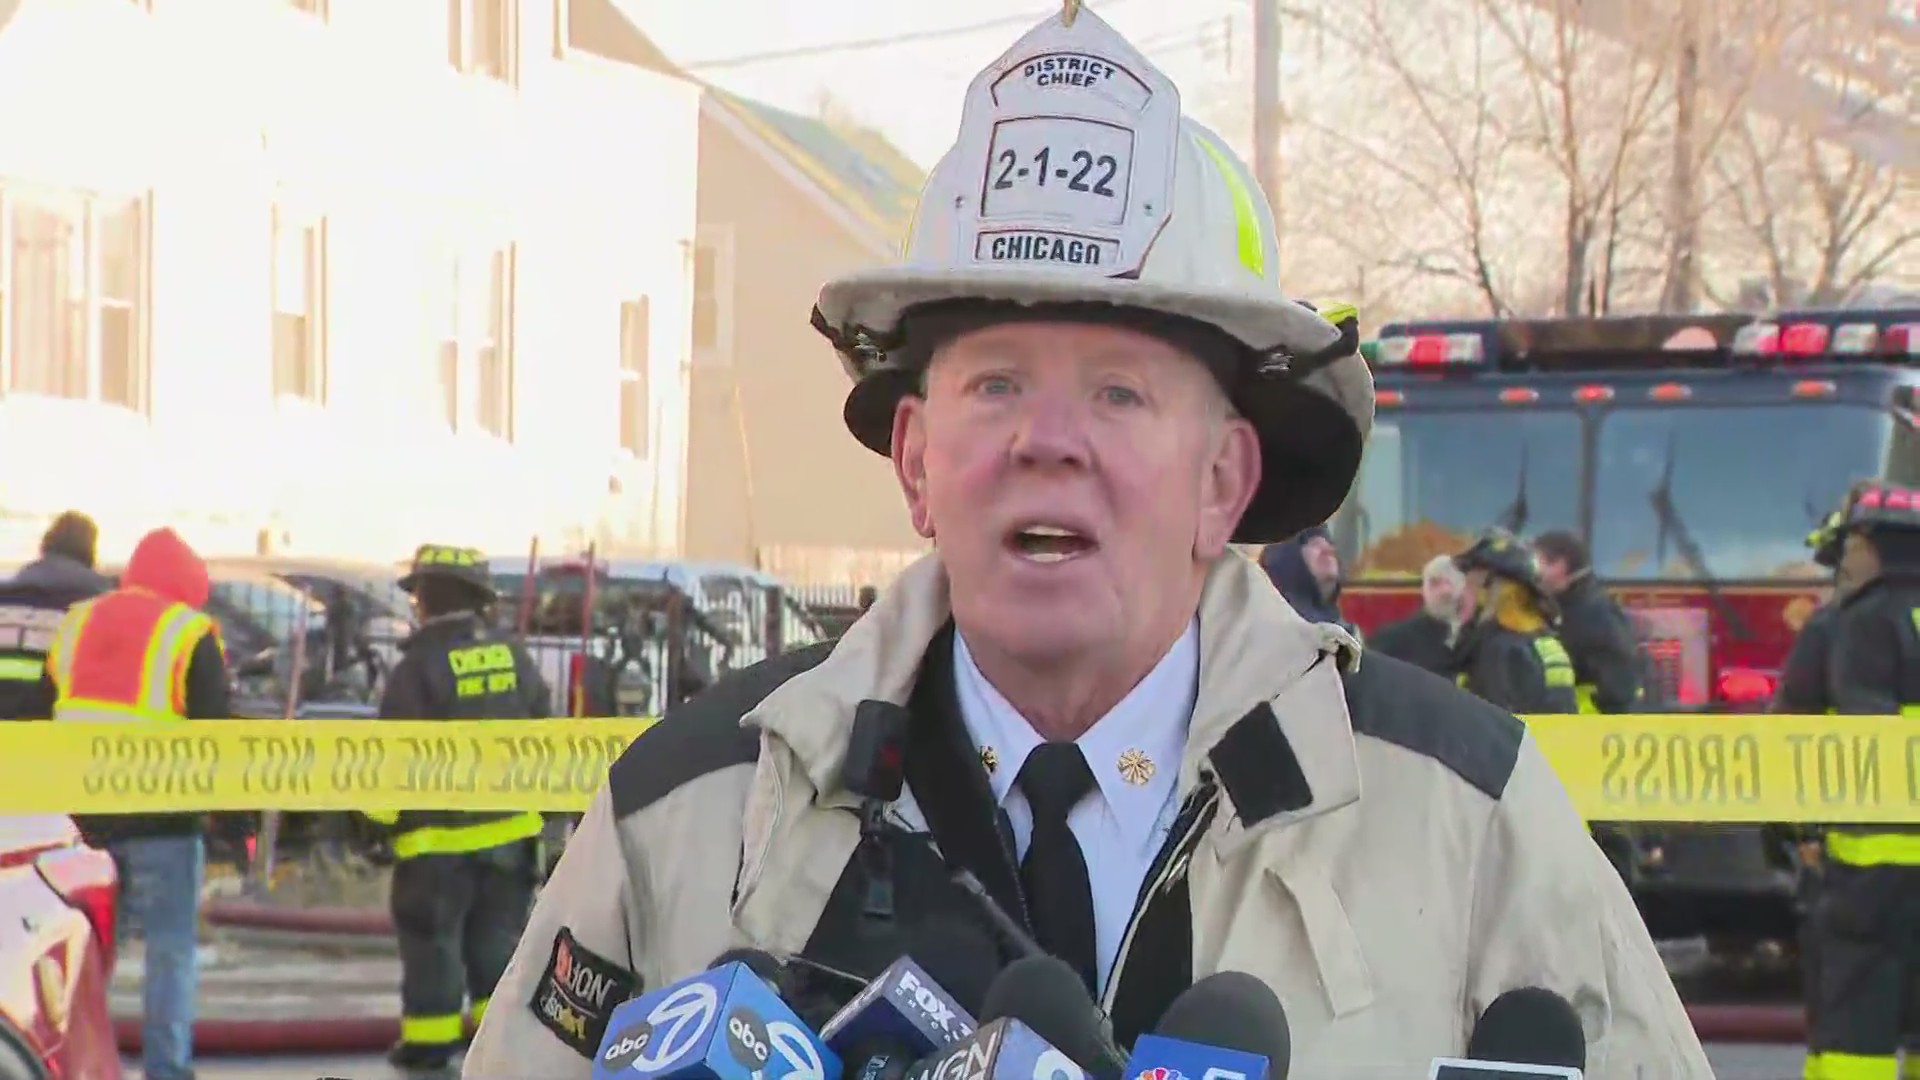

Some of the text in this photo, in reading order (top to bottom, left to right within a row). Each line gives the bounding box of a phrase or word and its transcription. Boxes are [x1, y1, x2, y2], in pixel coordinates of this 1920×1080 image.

[1024, 57, 1115, 79] DISTRICT
[1037, 73, 1097, 87] CHIEF
[993, 146, 1118, 197] 2-1-22
[991, 236, 1100, 265] CHICAGO
[899, 970, 956, 1033] FOX
[605, 1032, 650, 1060] abc
[729, 1017, 768, 1061] abc
